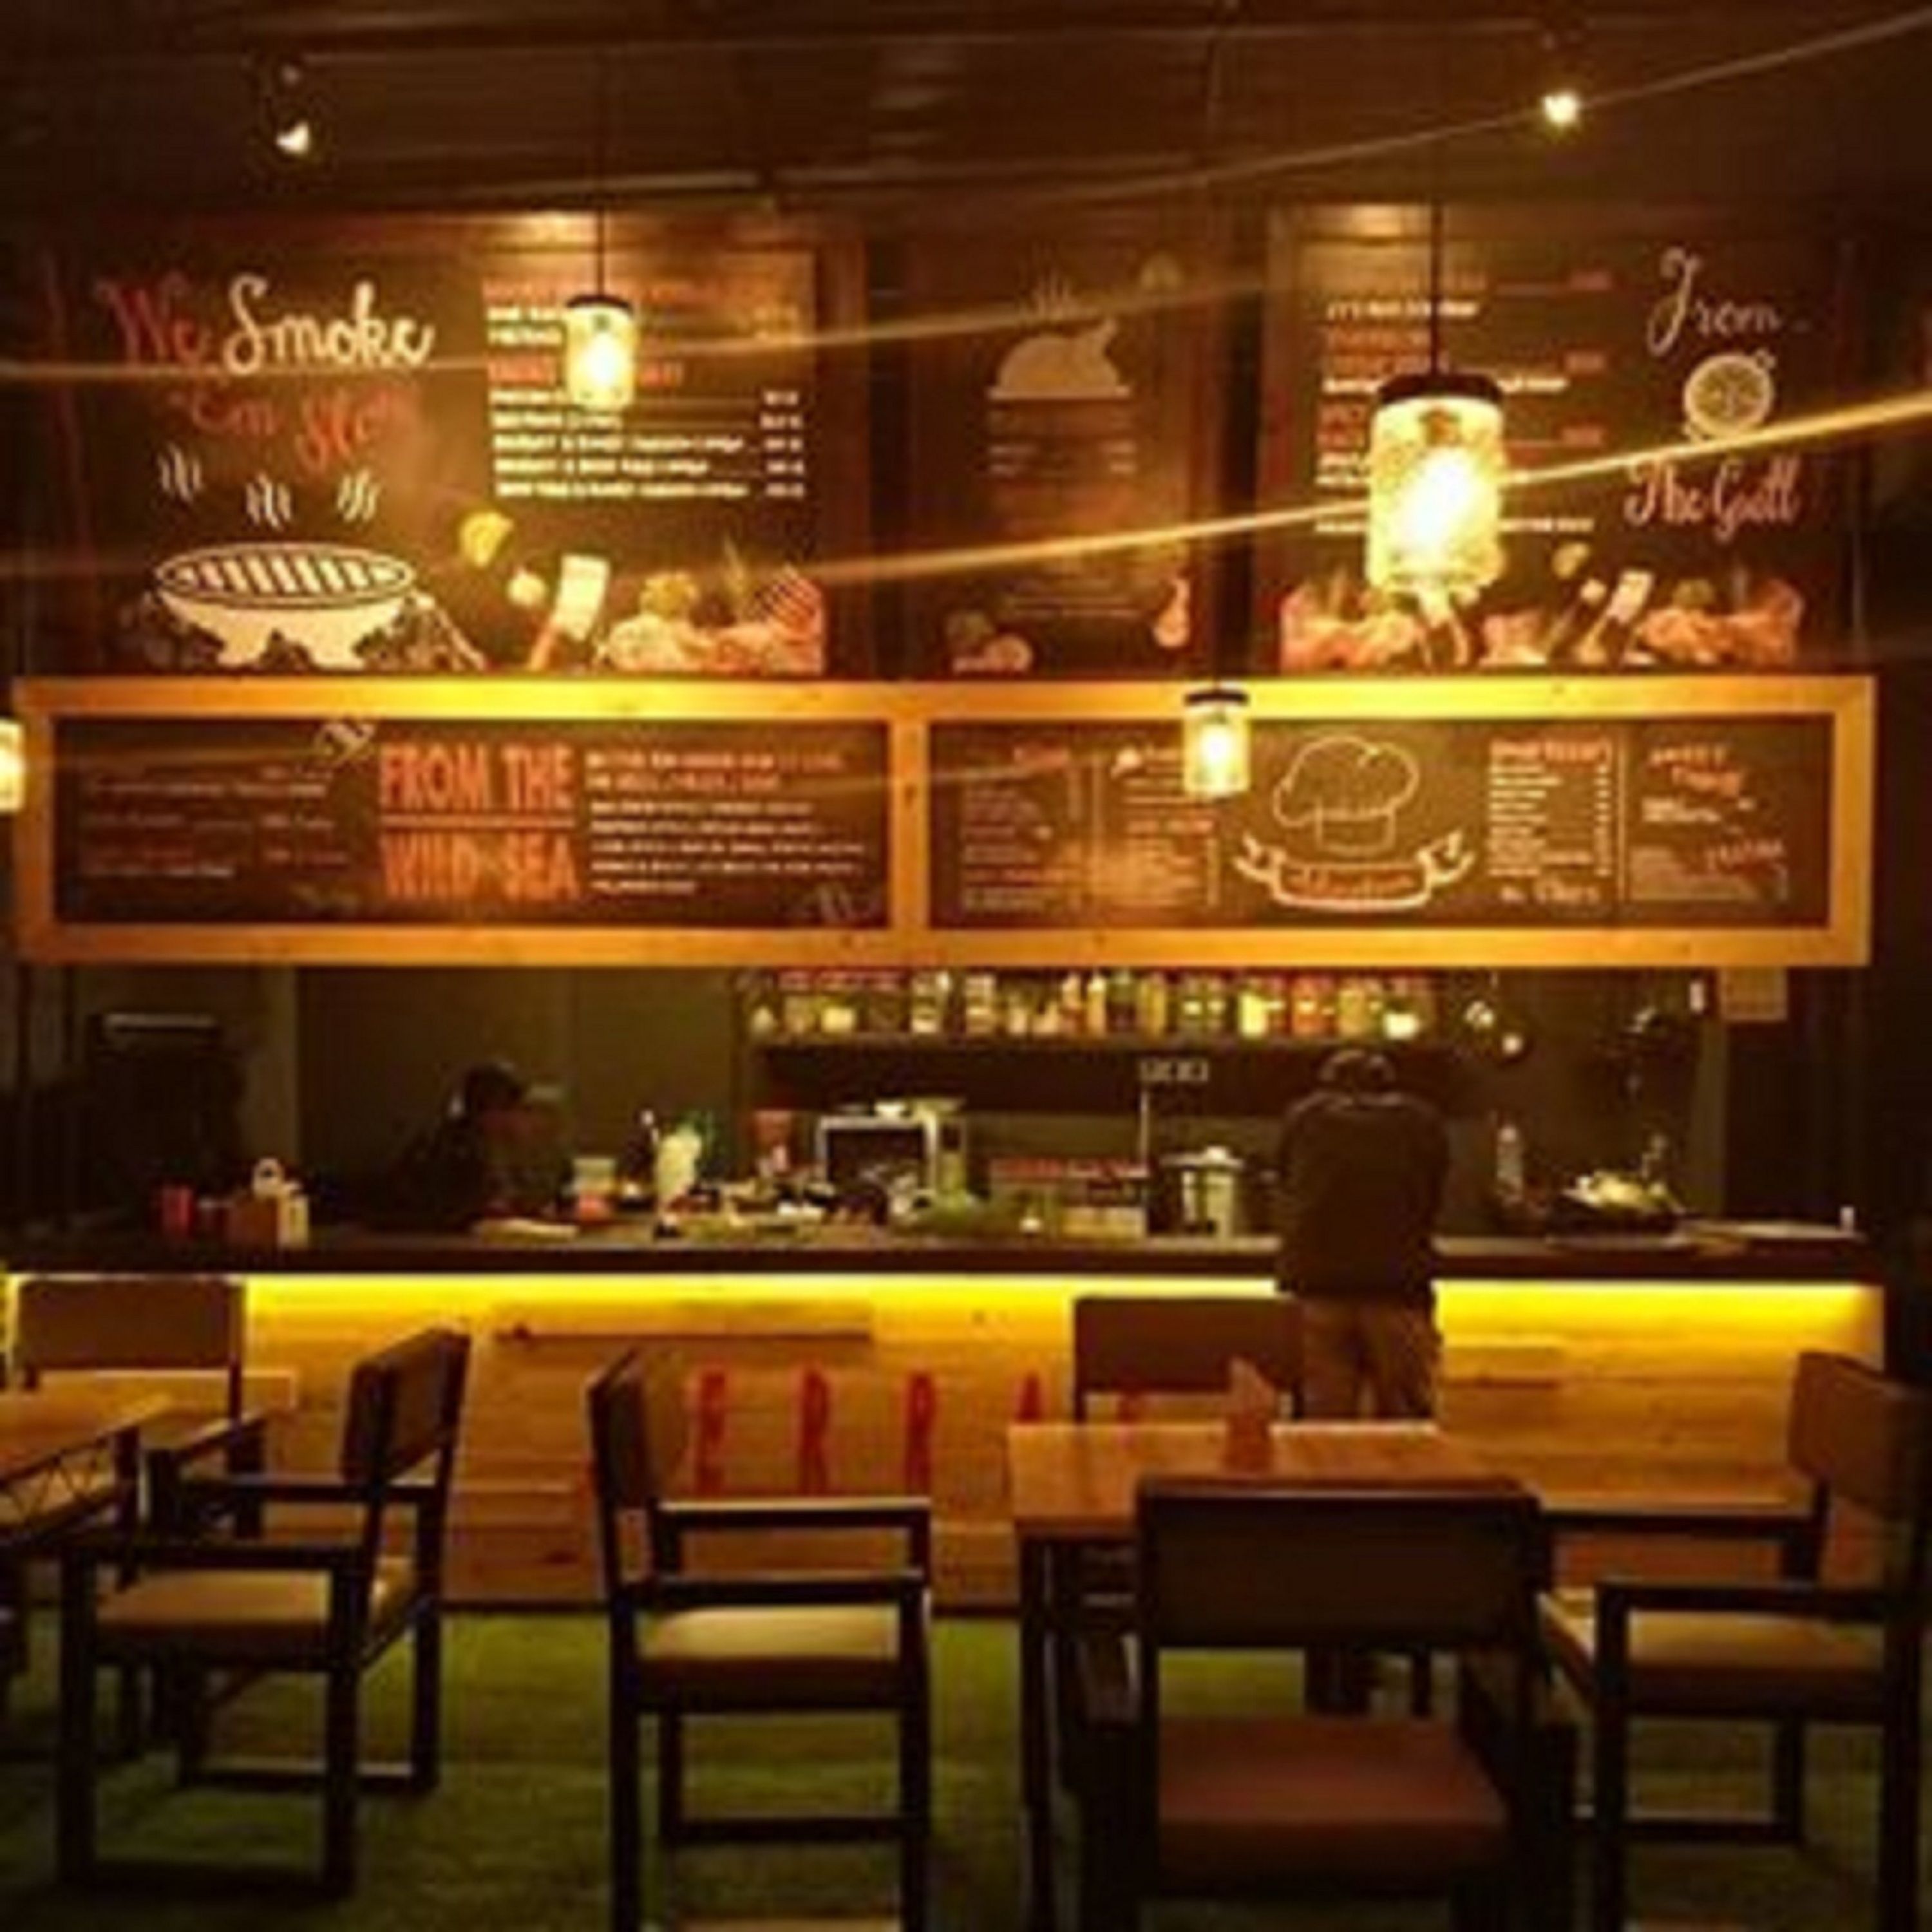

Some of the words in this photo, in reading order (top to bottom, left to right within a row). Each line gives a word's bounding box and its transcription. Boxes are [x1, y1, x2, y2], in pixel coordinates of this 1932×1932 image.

[93, 274, 210, 362] We
[222, 274, 437, 375] Smoke
[1647, 247, 1781, 356] From
[1623, 460, 1705, 526] The
[379, 742, 488, 810] FROM
[502, 743, 574, 810] THE
[504, 833, 578, 902] SEA
